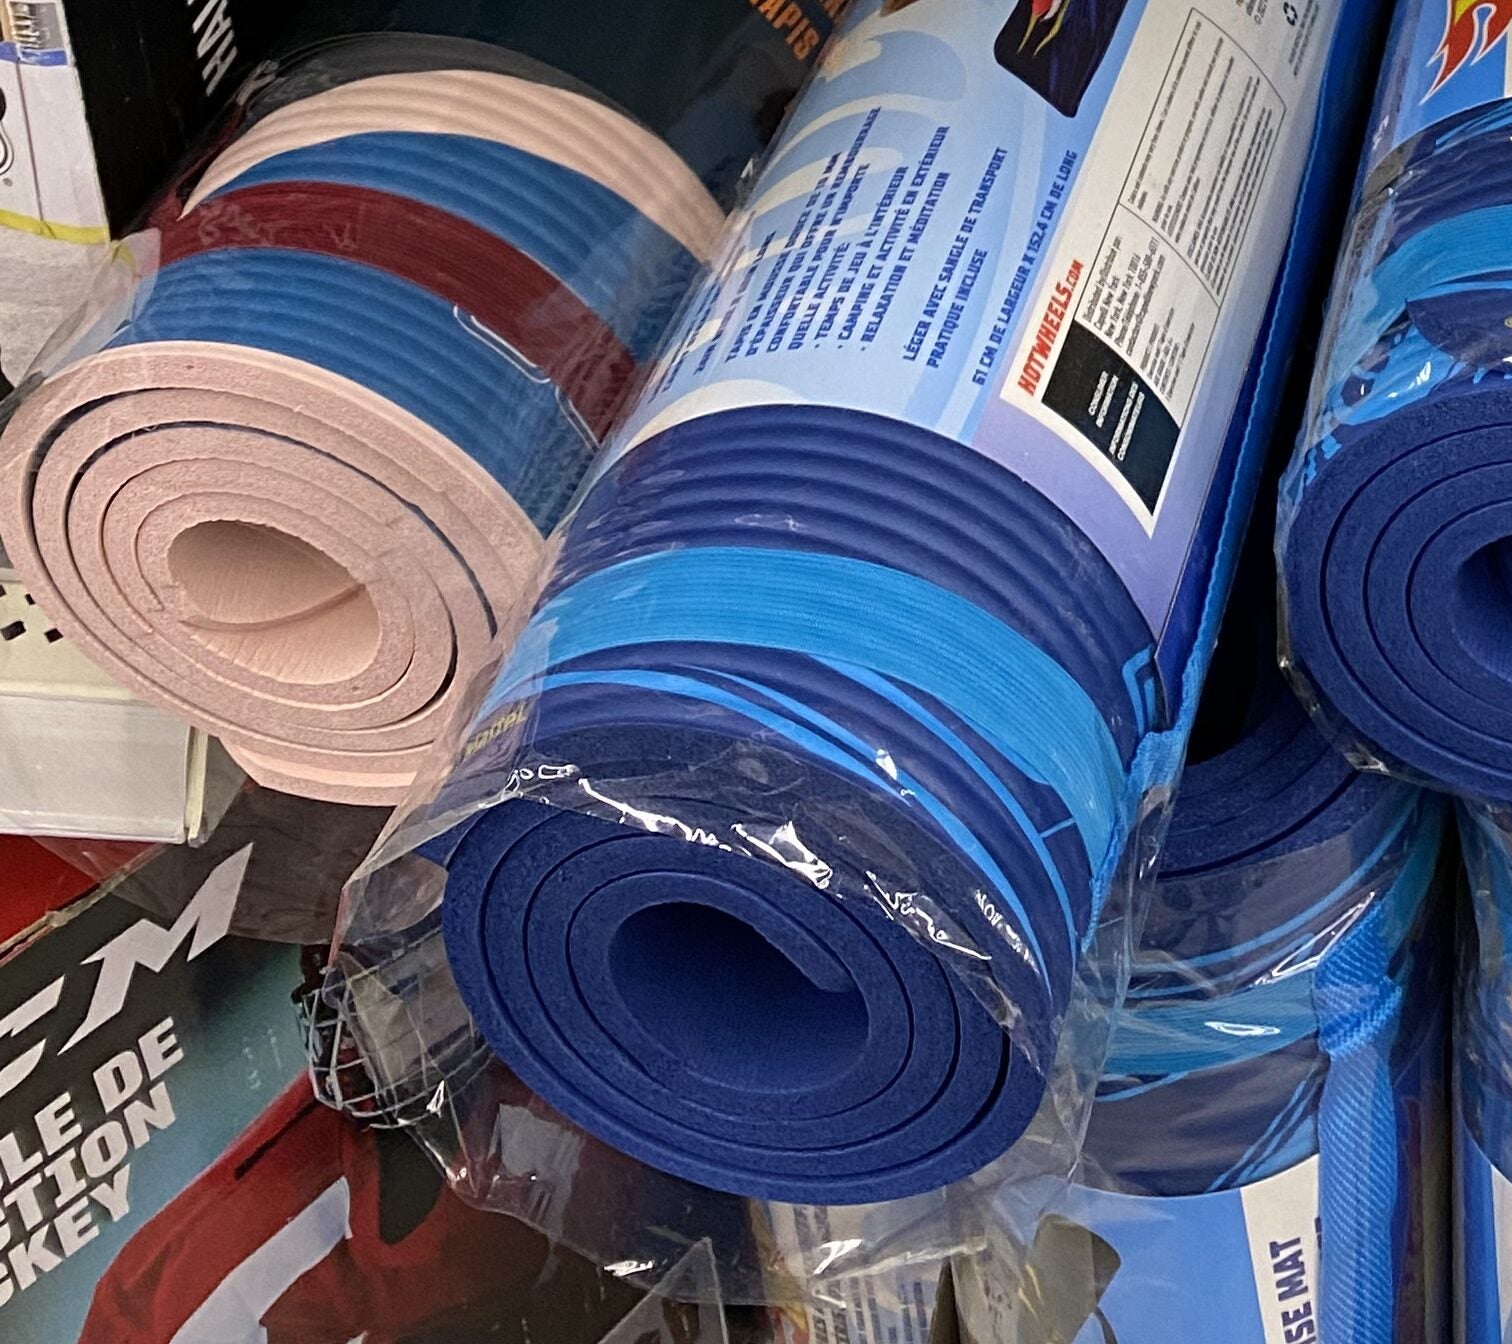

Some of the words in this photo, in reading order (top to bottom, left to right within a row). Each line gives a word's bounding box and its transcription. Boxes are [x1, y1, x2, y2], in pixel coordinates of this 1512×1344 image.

[967, 147, 1007, 214] TRANSPORT
[961, 213, 976, 234] DE
[939, 233, 965, 285] SANGLE
[979, 340, 998, 368] CM
[992, 320, 1006, 341] DE
[999, 269, 1029, 322] LARGEUR
[1055, 150, 1078, 185] LONG
[923, 284, 945, 319] AVEC
[927, 303, 962, 368] PRATIQUE
[955, 249, 988, 304] INCLUSE
[903, 316, 931, 363] LÉGER
[92, 1016, 184, 1114] DE
[1270, 1237, 1308, 1302] MAT
